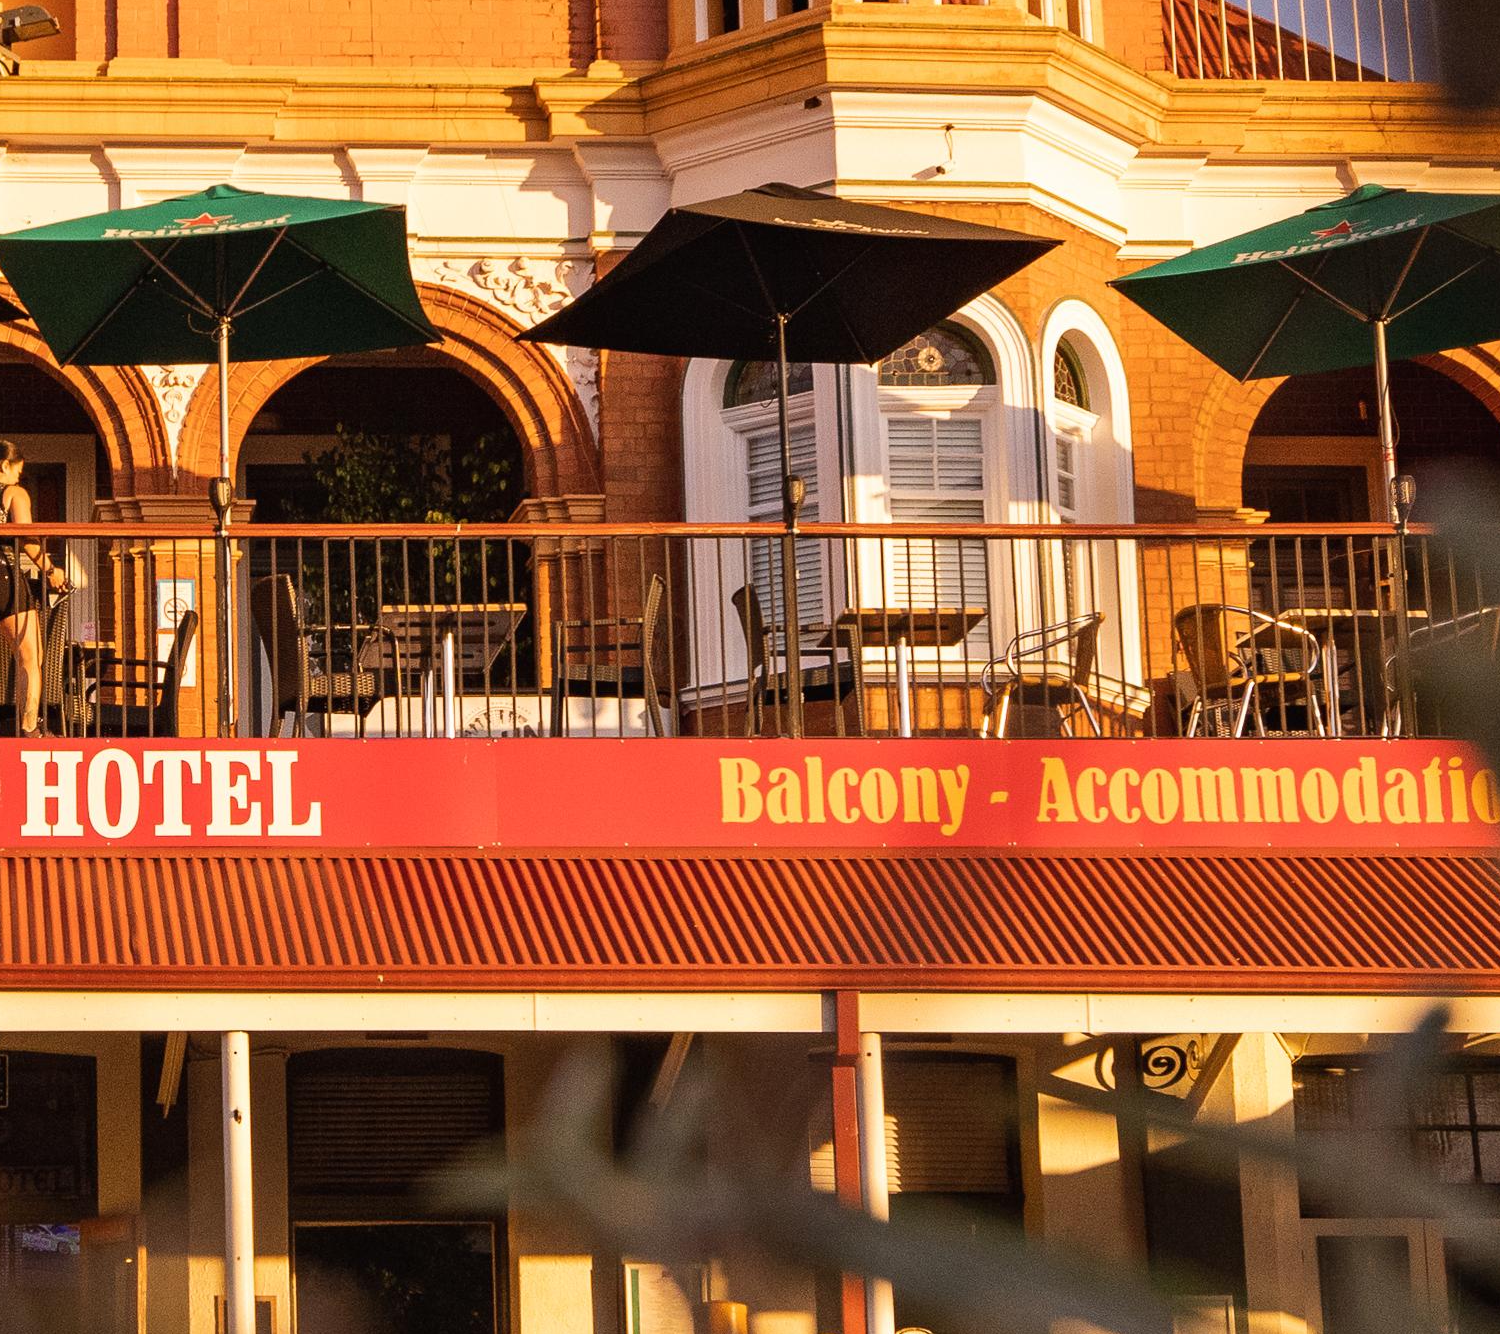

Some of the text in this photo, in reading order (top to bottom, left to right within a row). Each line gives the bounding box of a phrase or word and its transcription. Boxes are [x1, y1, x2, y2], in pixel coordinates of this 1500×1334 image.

[101, 215, 292, 238] Heineken
[1230, 214, 1424, 264] Heineken
[20, 746, 322, 839] HOTEL
[718, 755, 970, 836] Balcony
